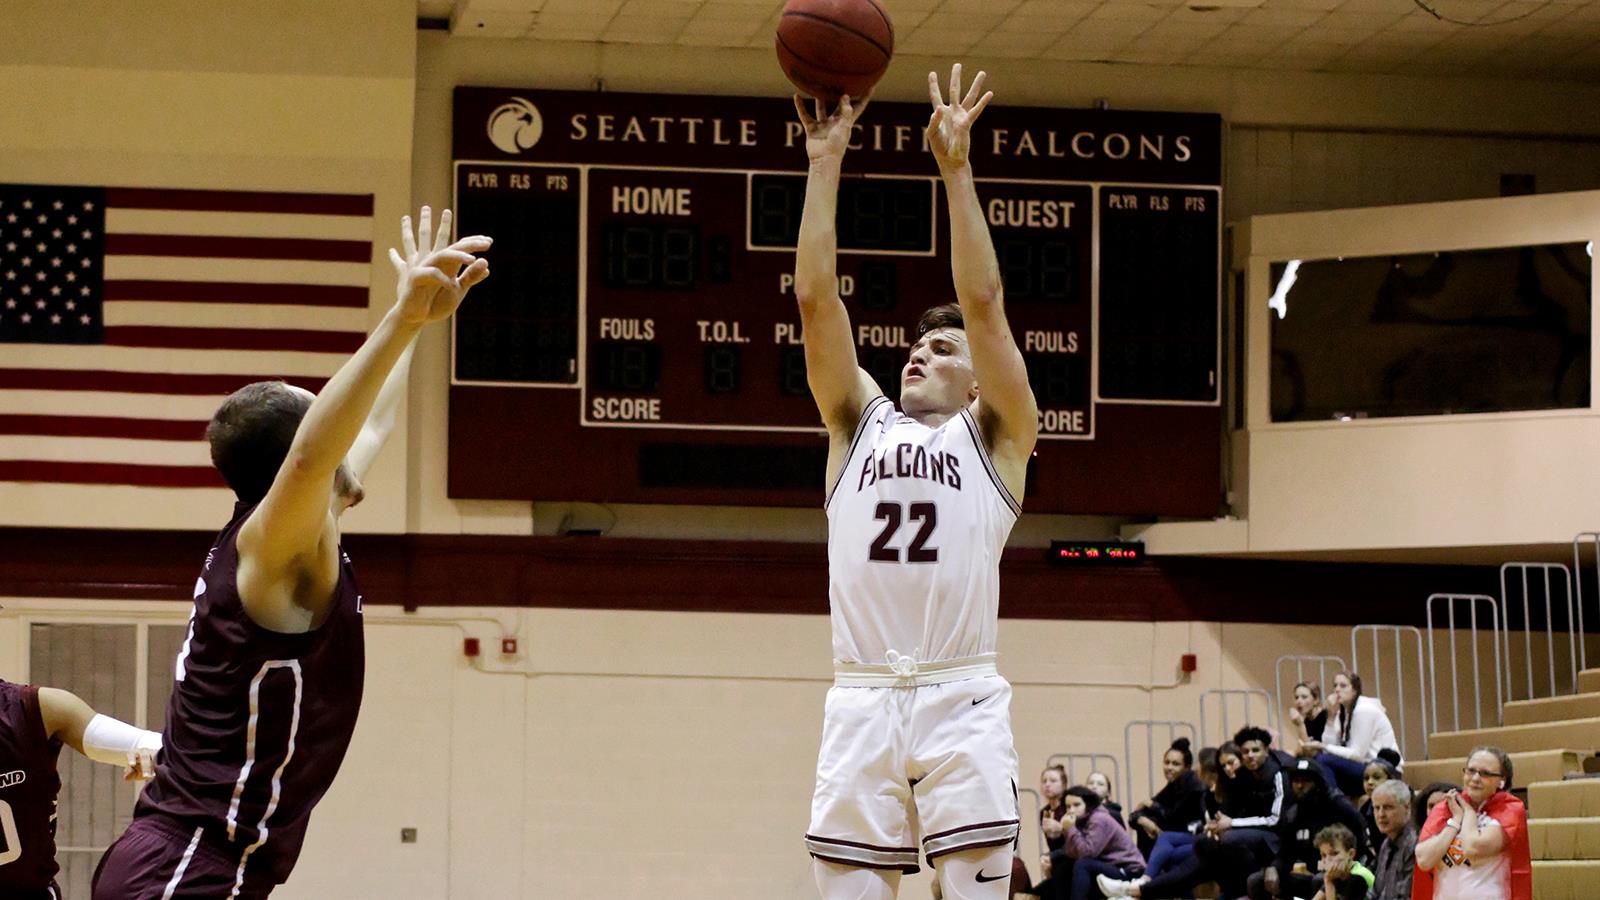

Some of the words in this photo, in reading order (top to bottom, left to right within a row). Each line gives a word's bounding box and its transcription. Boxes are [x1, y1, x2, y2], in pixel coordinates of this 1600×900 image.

[570, 113, 757, 146] SEATTLE
[785, 121, 930, 152] PCIFI
[992, 129, 1191, 162] FALCONS
[468, 172, 498, 188] PLYR
[510, 174, 530, 189] FLS
[546, 175, 568, 190] PTS
[612, 186, 692, 216] HOME
[1109, 193, 1138, 209] PLYR
[1149, 195, 1169, 211] FLS
[1184, 196, 1206, 212] PTS
[988, 199, 1075, 228] GUEST
[600, 317, 655, 341] FOULS
[697, 320, 750, 342] T.O.L.
[858, 325, 911, 348] FOUL
[1025, 331, 1079, 353] FOULS
[592, 397, 661, 420] SCORE
[1037, 409, 1084, 432] CORE
[868, 499, 939, 564] 22
